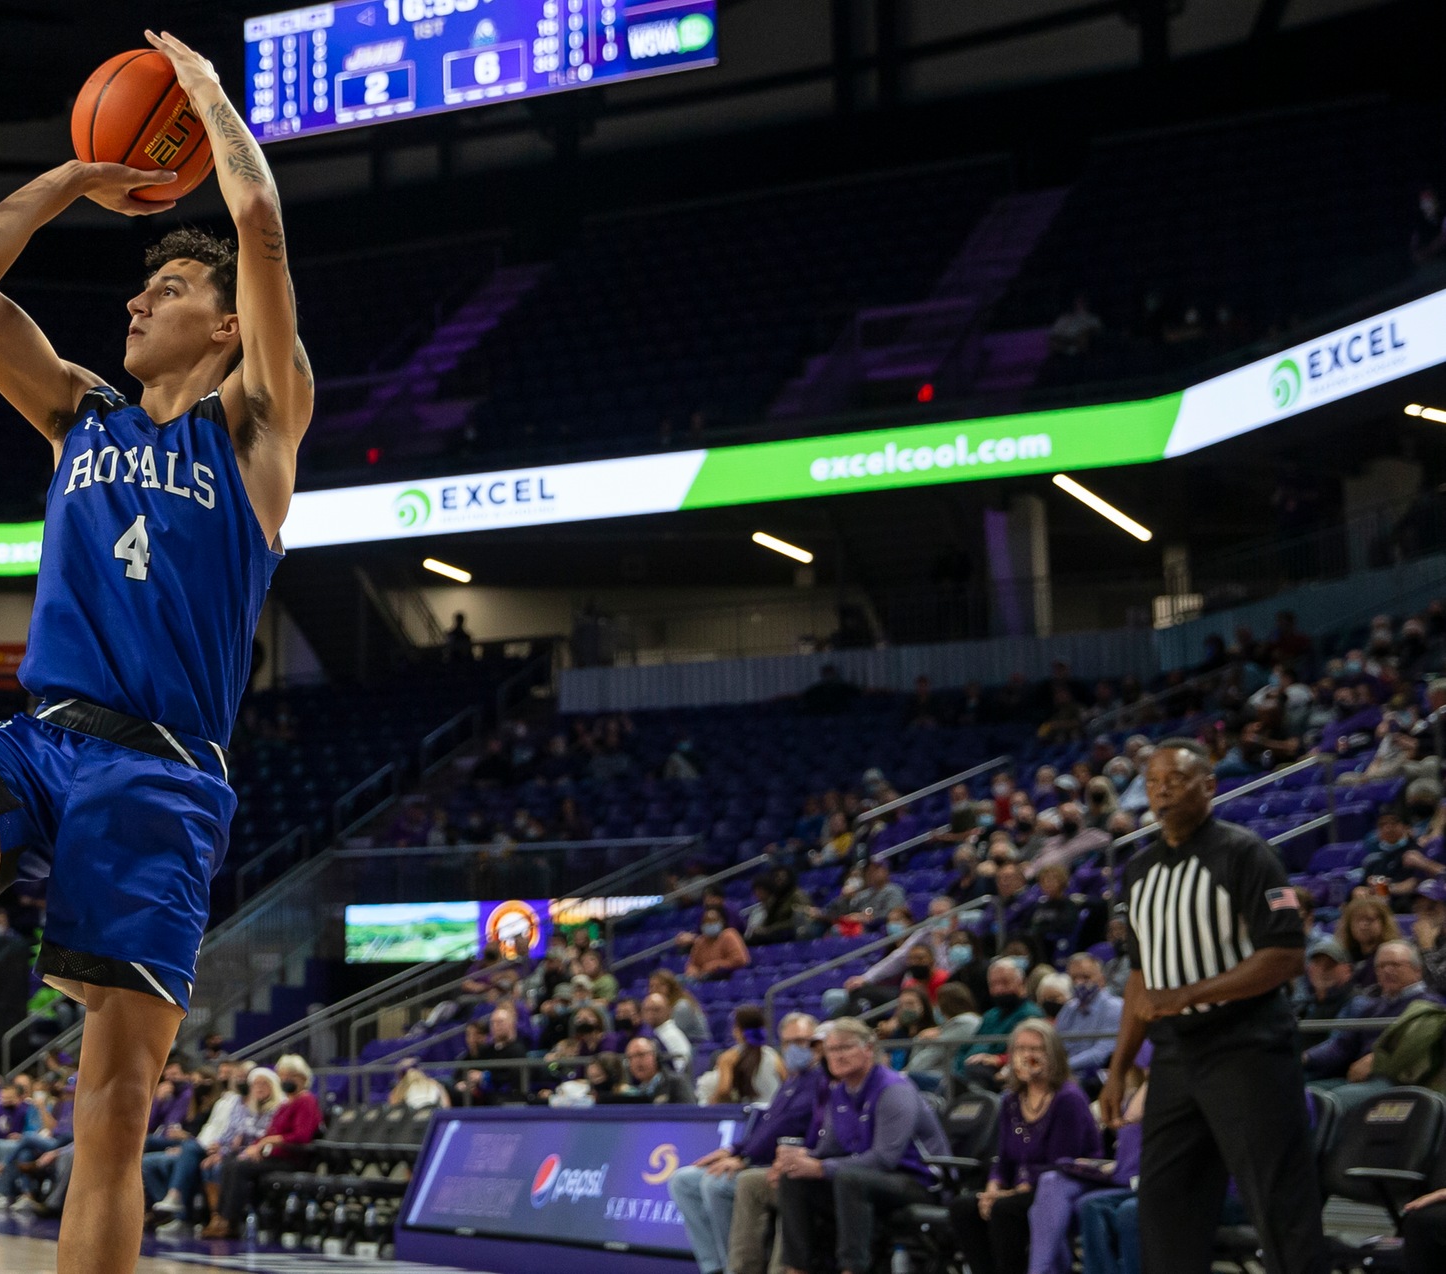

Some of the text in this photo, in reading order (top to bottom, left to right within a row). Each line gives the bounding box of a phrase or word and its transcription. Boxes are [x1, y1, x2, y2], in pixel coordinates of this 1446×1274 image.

[365, 71, 389, 105] 2
[474, 52, 500, 84] 6
[144, 94, 186, 154] AMPIONSHIP
[148, 99, 199, 167] LITE
[1307, 321, 1406, 379] EXCEL
[64, 445, 215, 510] ROYALS
[810, 433, 1052, 481] excelcool.com
[442, 478, 555, 509] EXCEL
[114, 514, 151, 581] 4
[551, 1163, 610, 1204] pepsi
